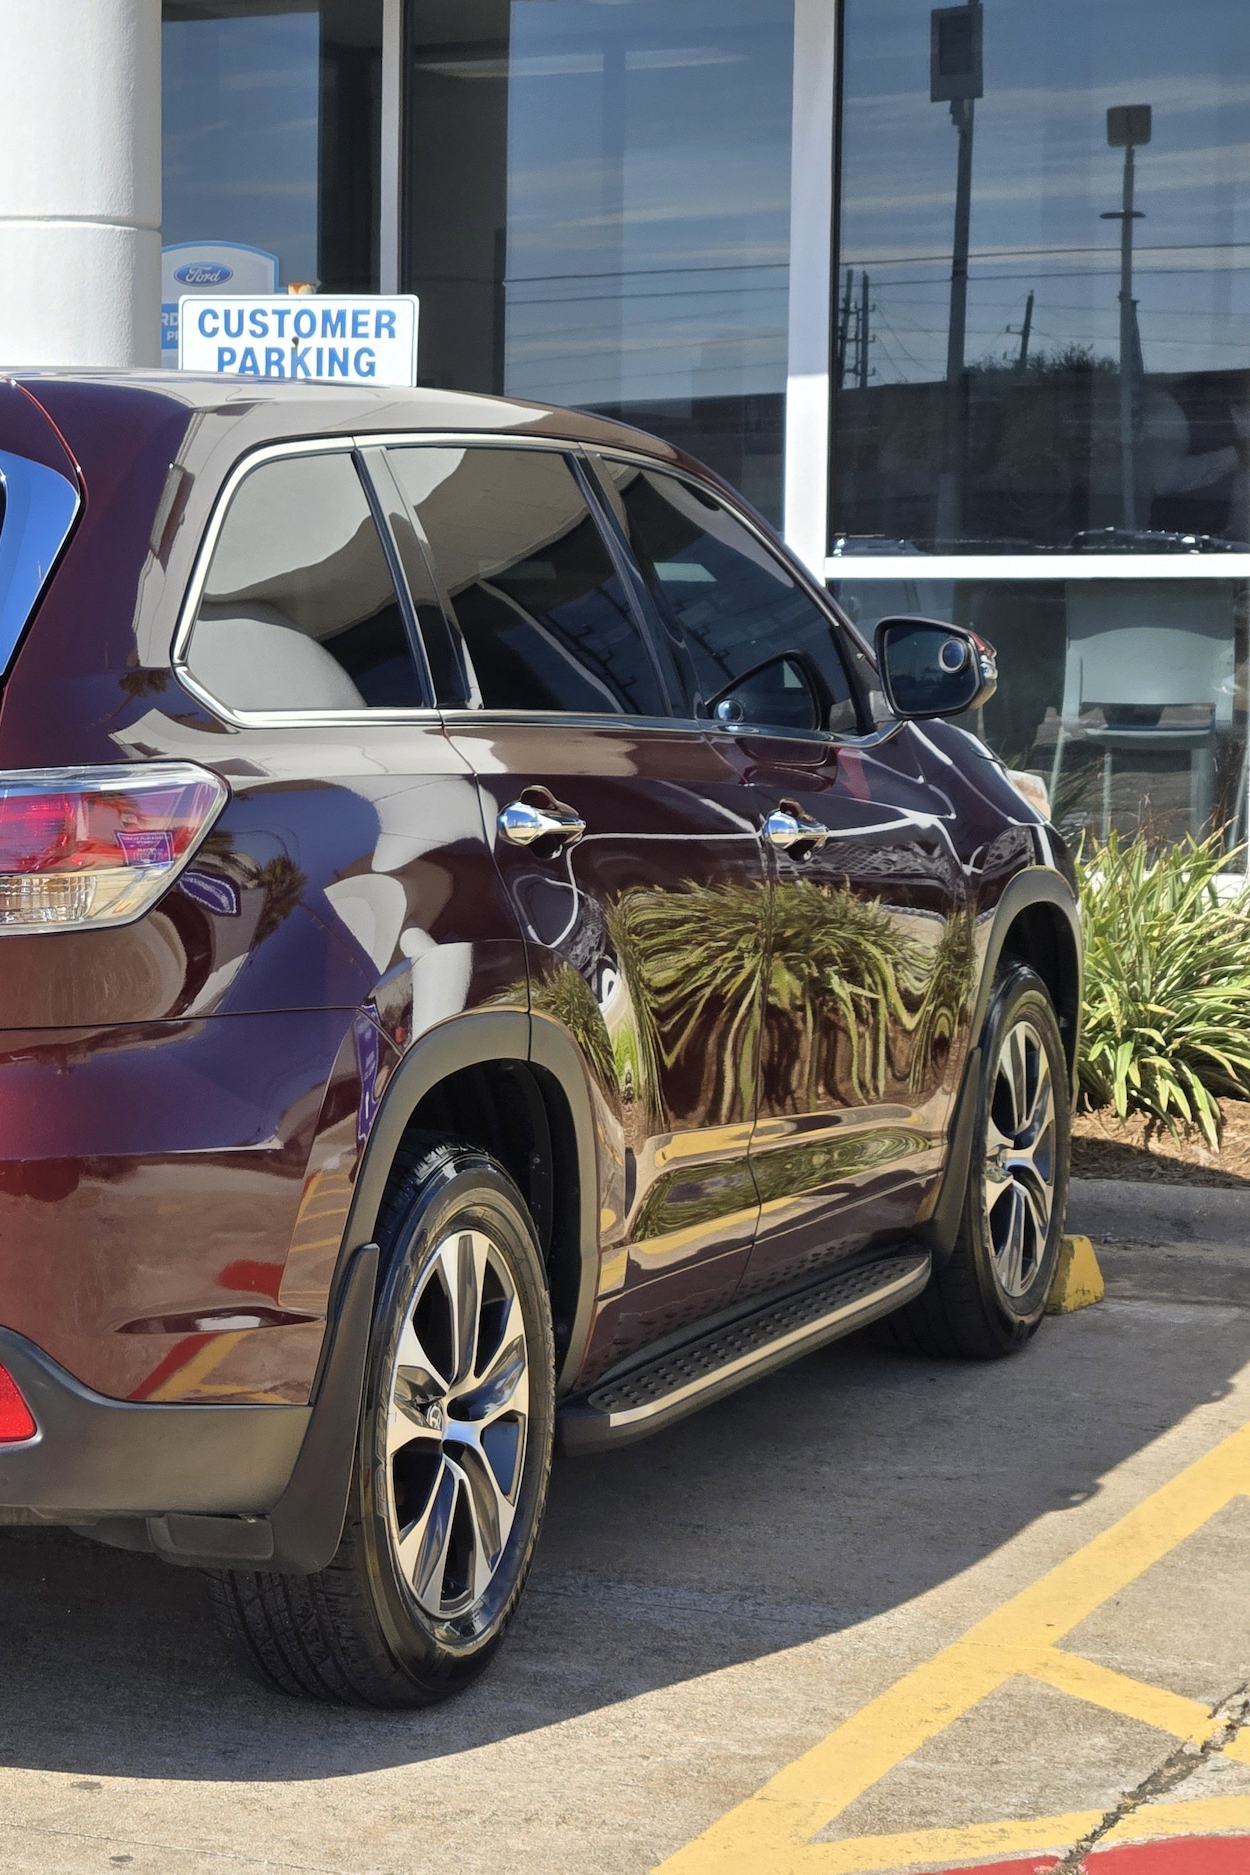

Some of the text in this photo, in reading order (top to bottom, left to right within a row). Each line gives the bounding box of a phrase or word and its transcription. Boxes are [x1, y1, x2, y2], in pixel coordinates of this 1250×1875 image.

[185, 266, 222, 283] Ford
[198, 308, 398, 339] CUSTOMER
[217, 346, 376, 379] PARKING
